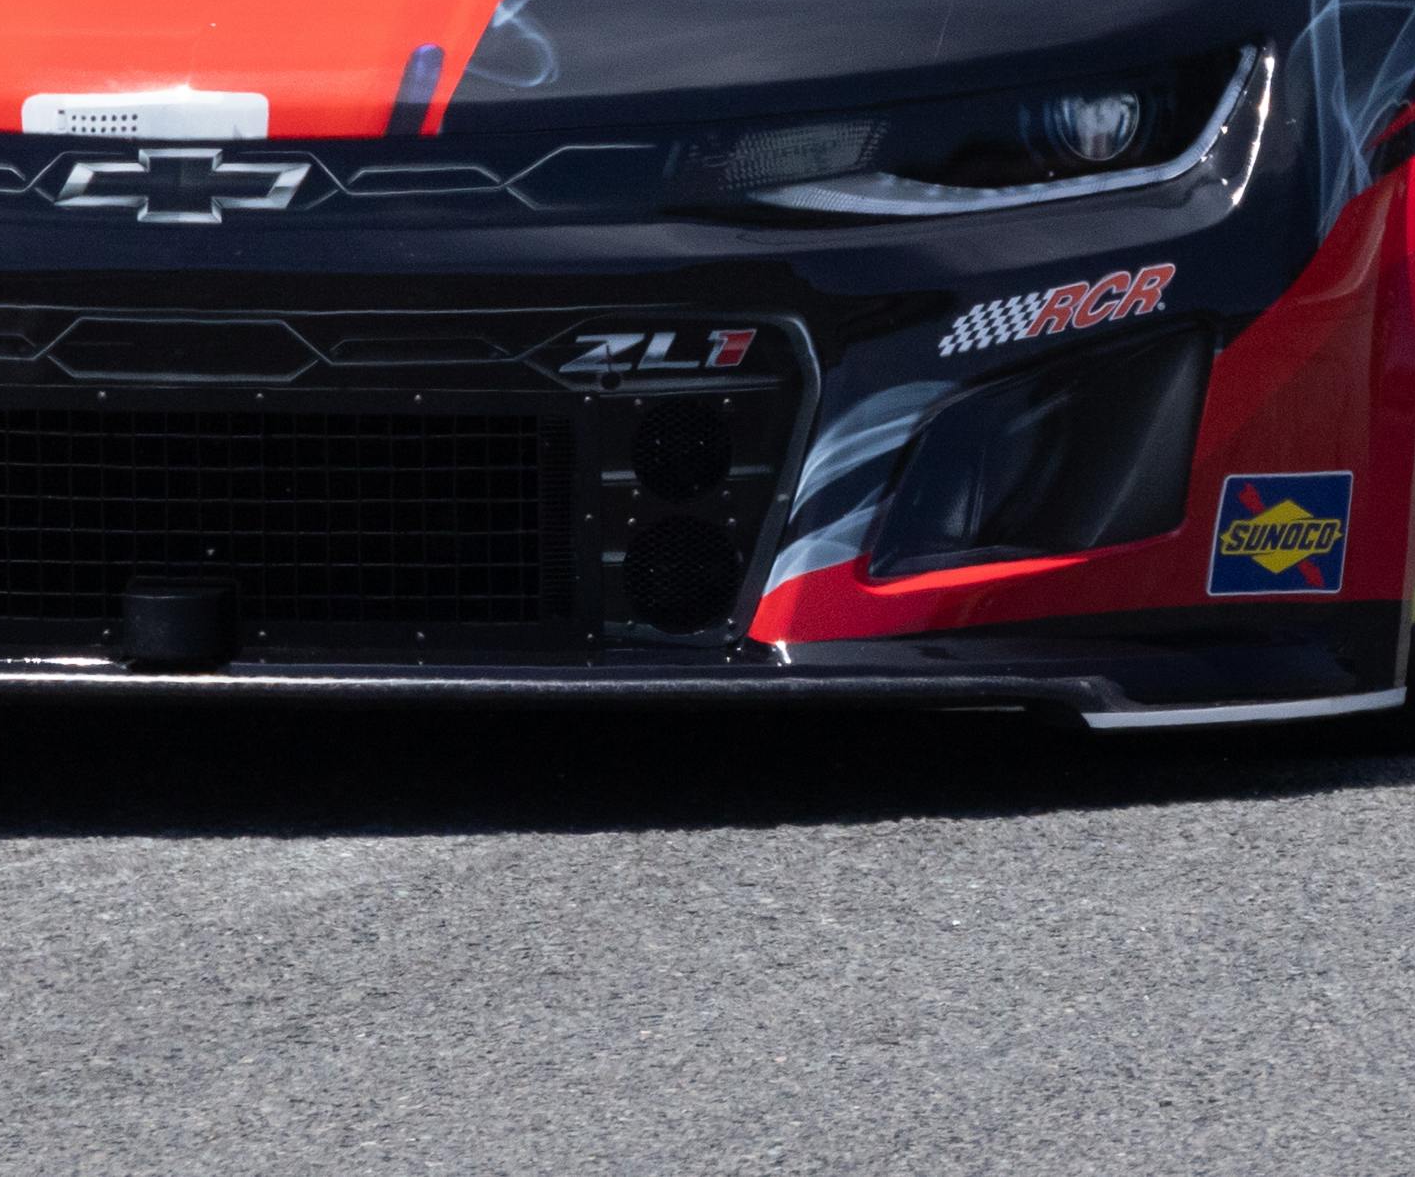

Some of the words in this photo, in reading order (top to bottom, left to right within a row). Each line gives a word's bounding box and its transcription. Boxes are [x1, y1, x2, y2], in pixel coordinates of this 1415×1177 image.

[1027, 263, 1176, 337] RCR
[558, 328, 758, 373] ZL1
[1227, 522, 1338, 554] SUNOCO
